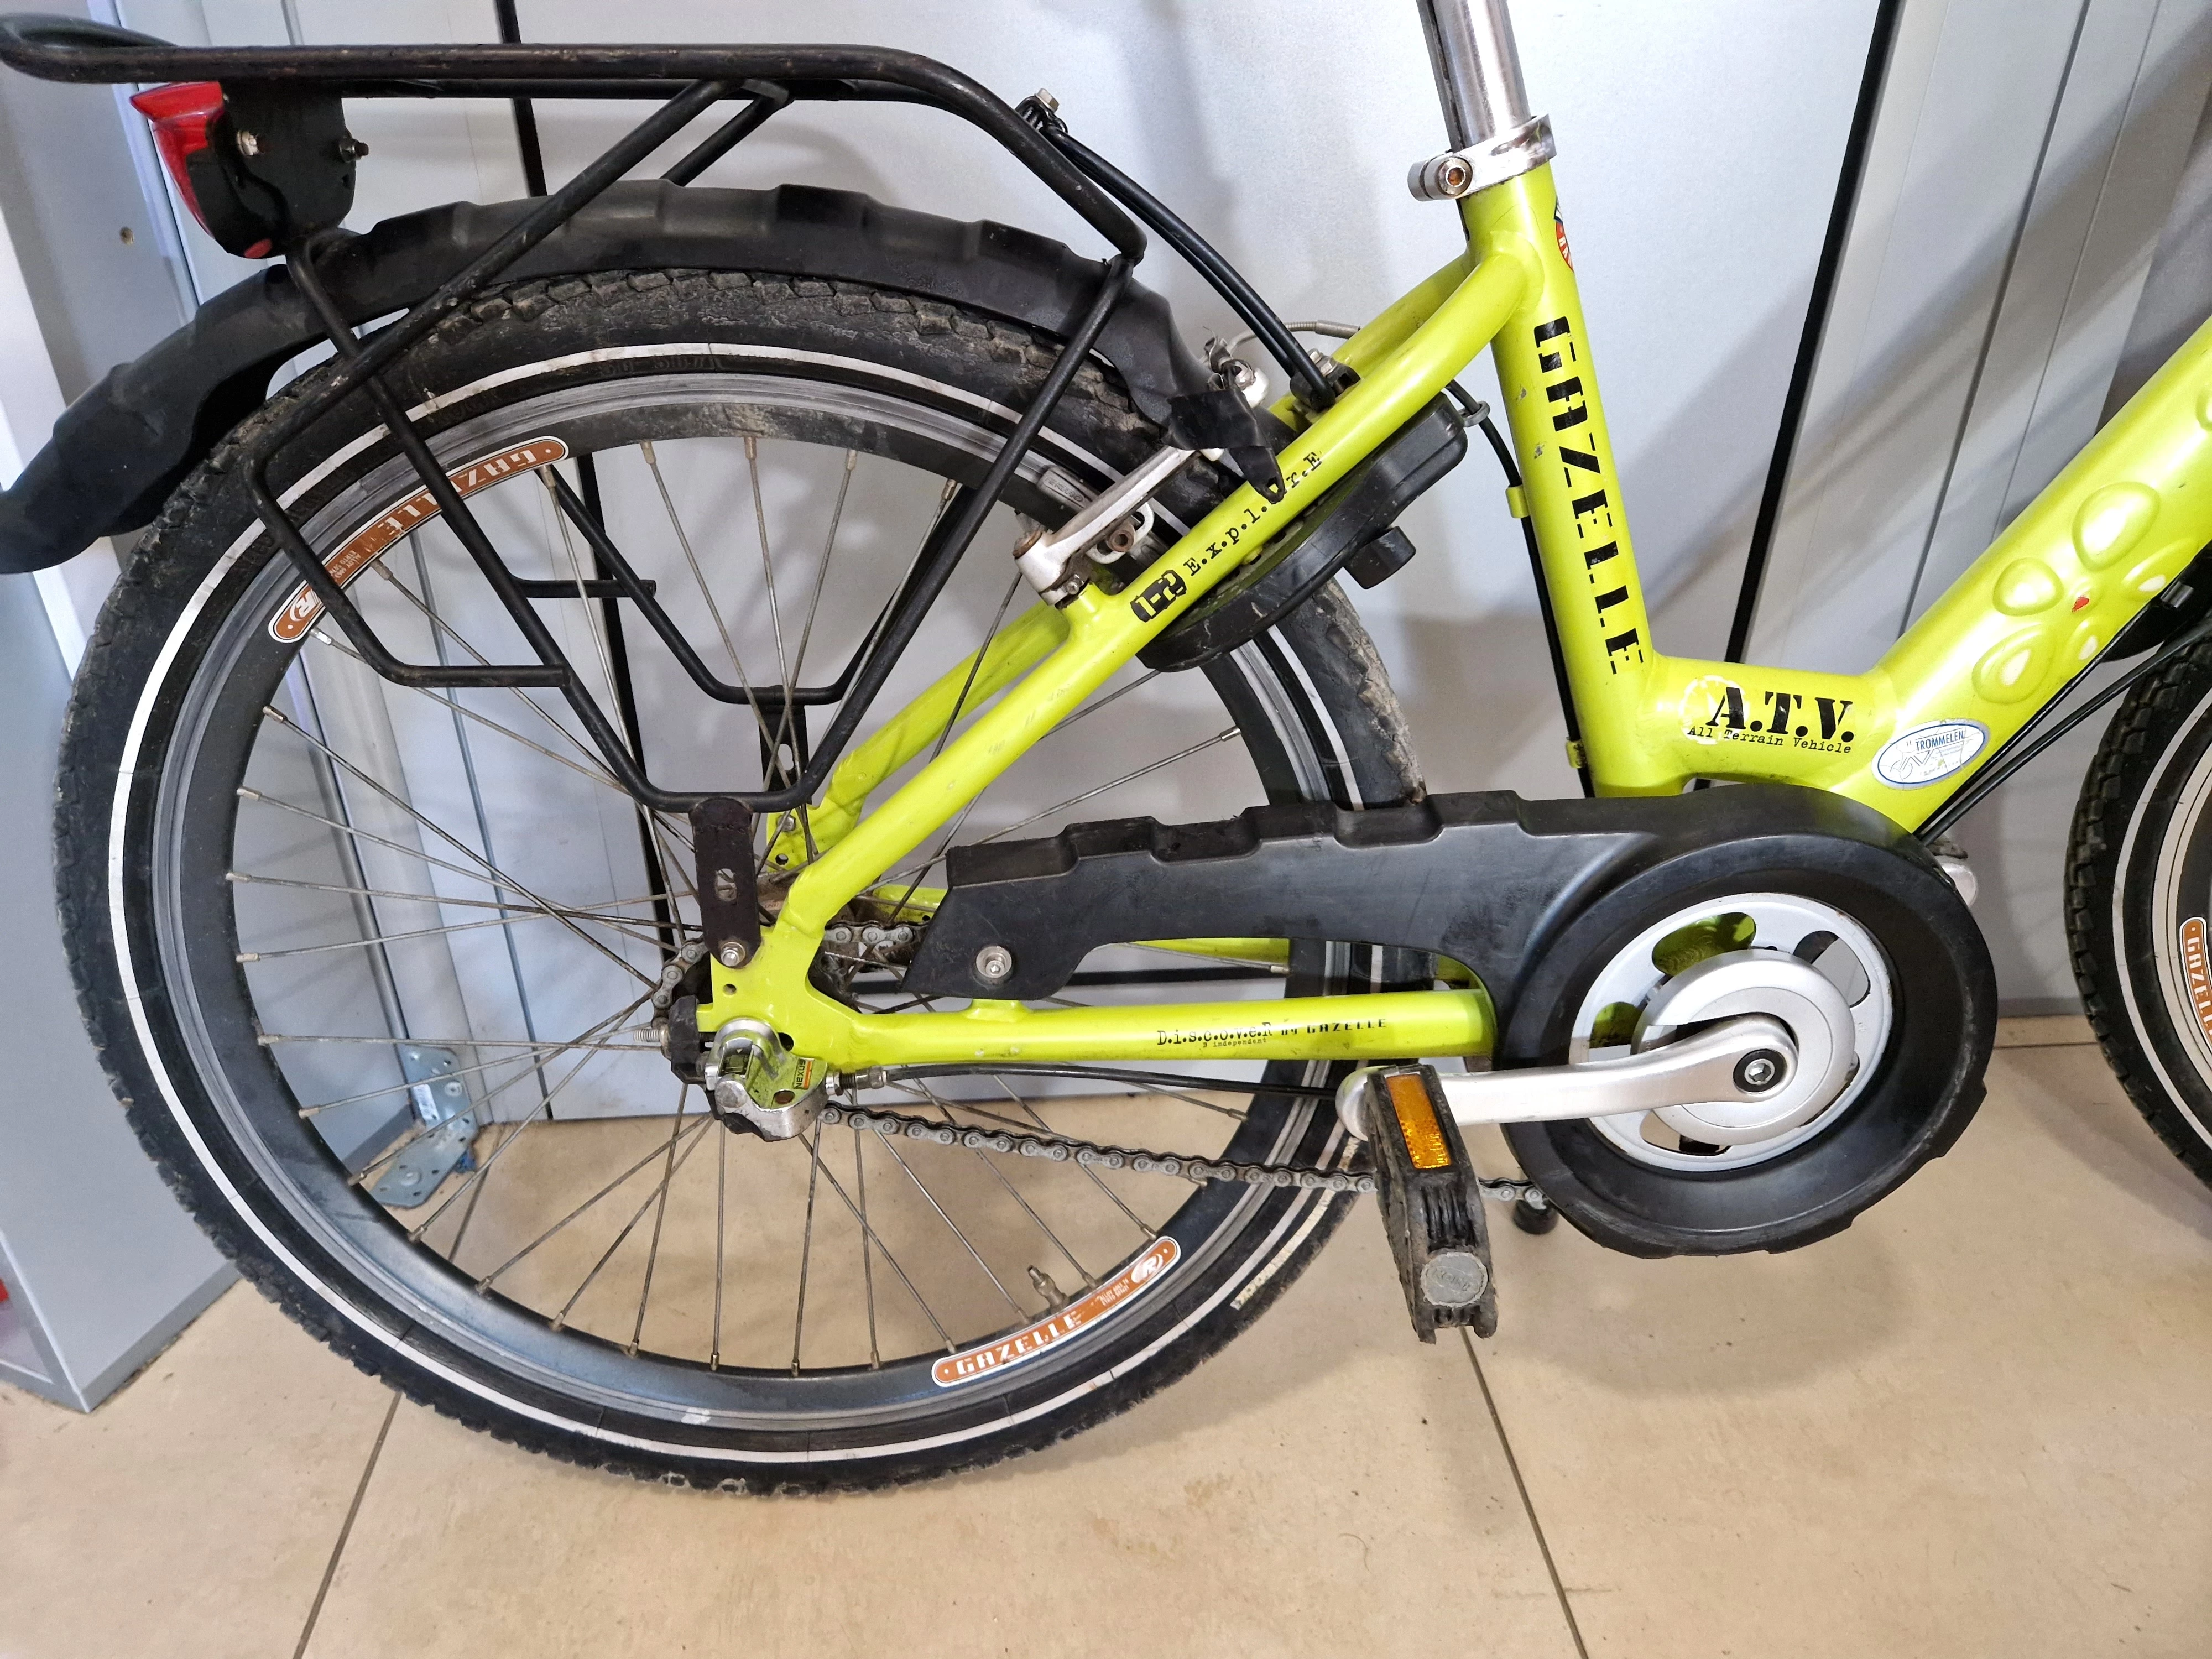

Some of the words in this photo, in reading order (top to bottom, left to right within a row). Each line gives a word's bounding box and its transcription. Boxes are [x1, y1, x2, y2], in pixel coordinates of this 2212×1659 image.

[378, 448, 536, 536] GAZLLE
[1533, 315, 1644, 675] GAZELLE
[1705, 686, 1854, 742] A.T.V.
[1687, 726, 1713, 738] All
[1724, 729, 1783, 747] Terrain
[1793, 737, 1852, 754] Vehicle
[1915, 730, 1964, 752] TROMMELEN
[2187, 936, 2212, 1036] GAZELL
[1213, 1037, 1267, 1047] independent
[1306, 1019, 1386, 1034] GAZELLE
[793, 1058, 806, 1089] NEXUS
[956, 1310, 1082, 1376] GAZELLE
